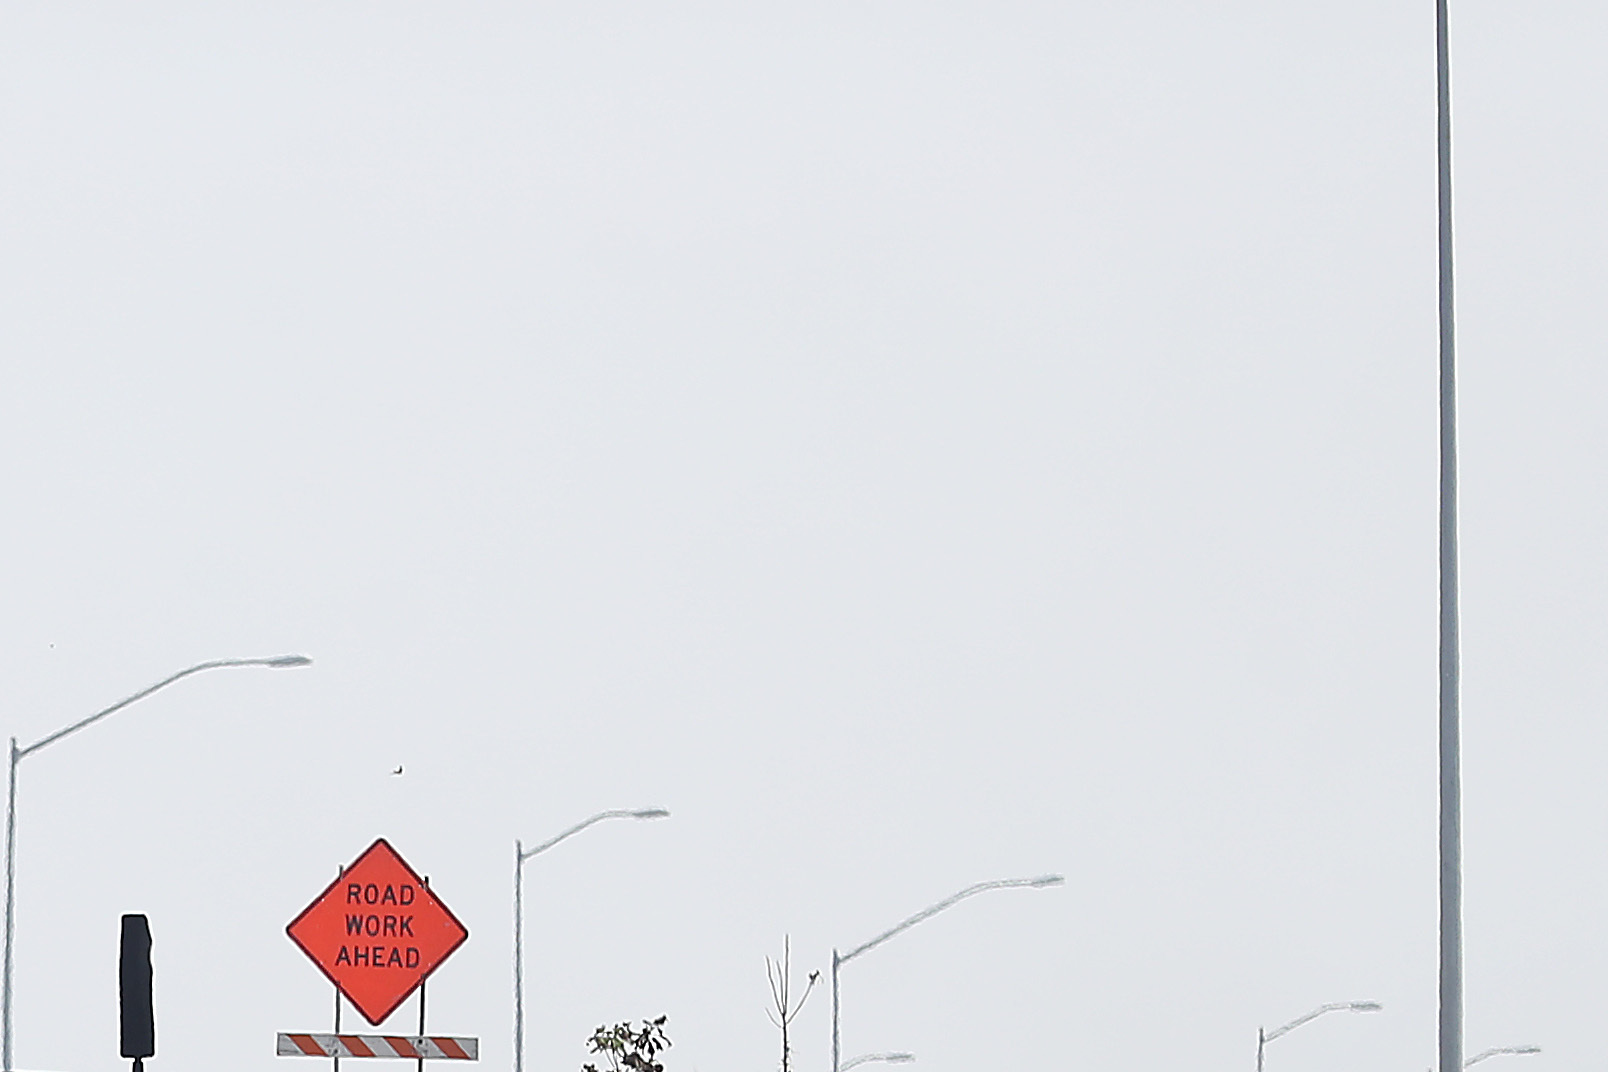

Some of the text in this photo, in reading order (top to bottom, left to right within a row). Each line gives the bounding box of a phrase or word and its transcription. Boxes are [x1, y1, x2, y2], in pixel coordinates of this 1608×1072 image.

[346, 883, 415, 906] ROAD
[345, 913, 414, 938] WORK
[334, 945, 420, 969] AHEAD
